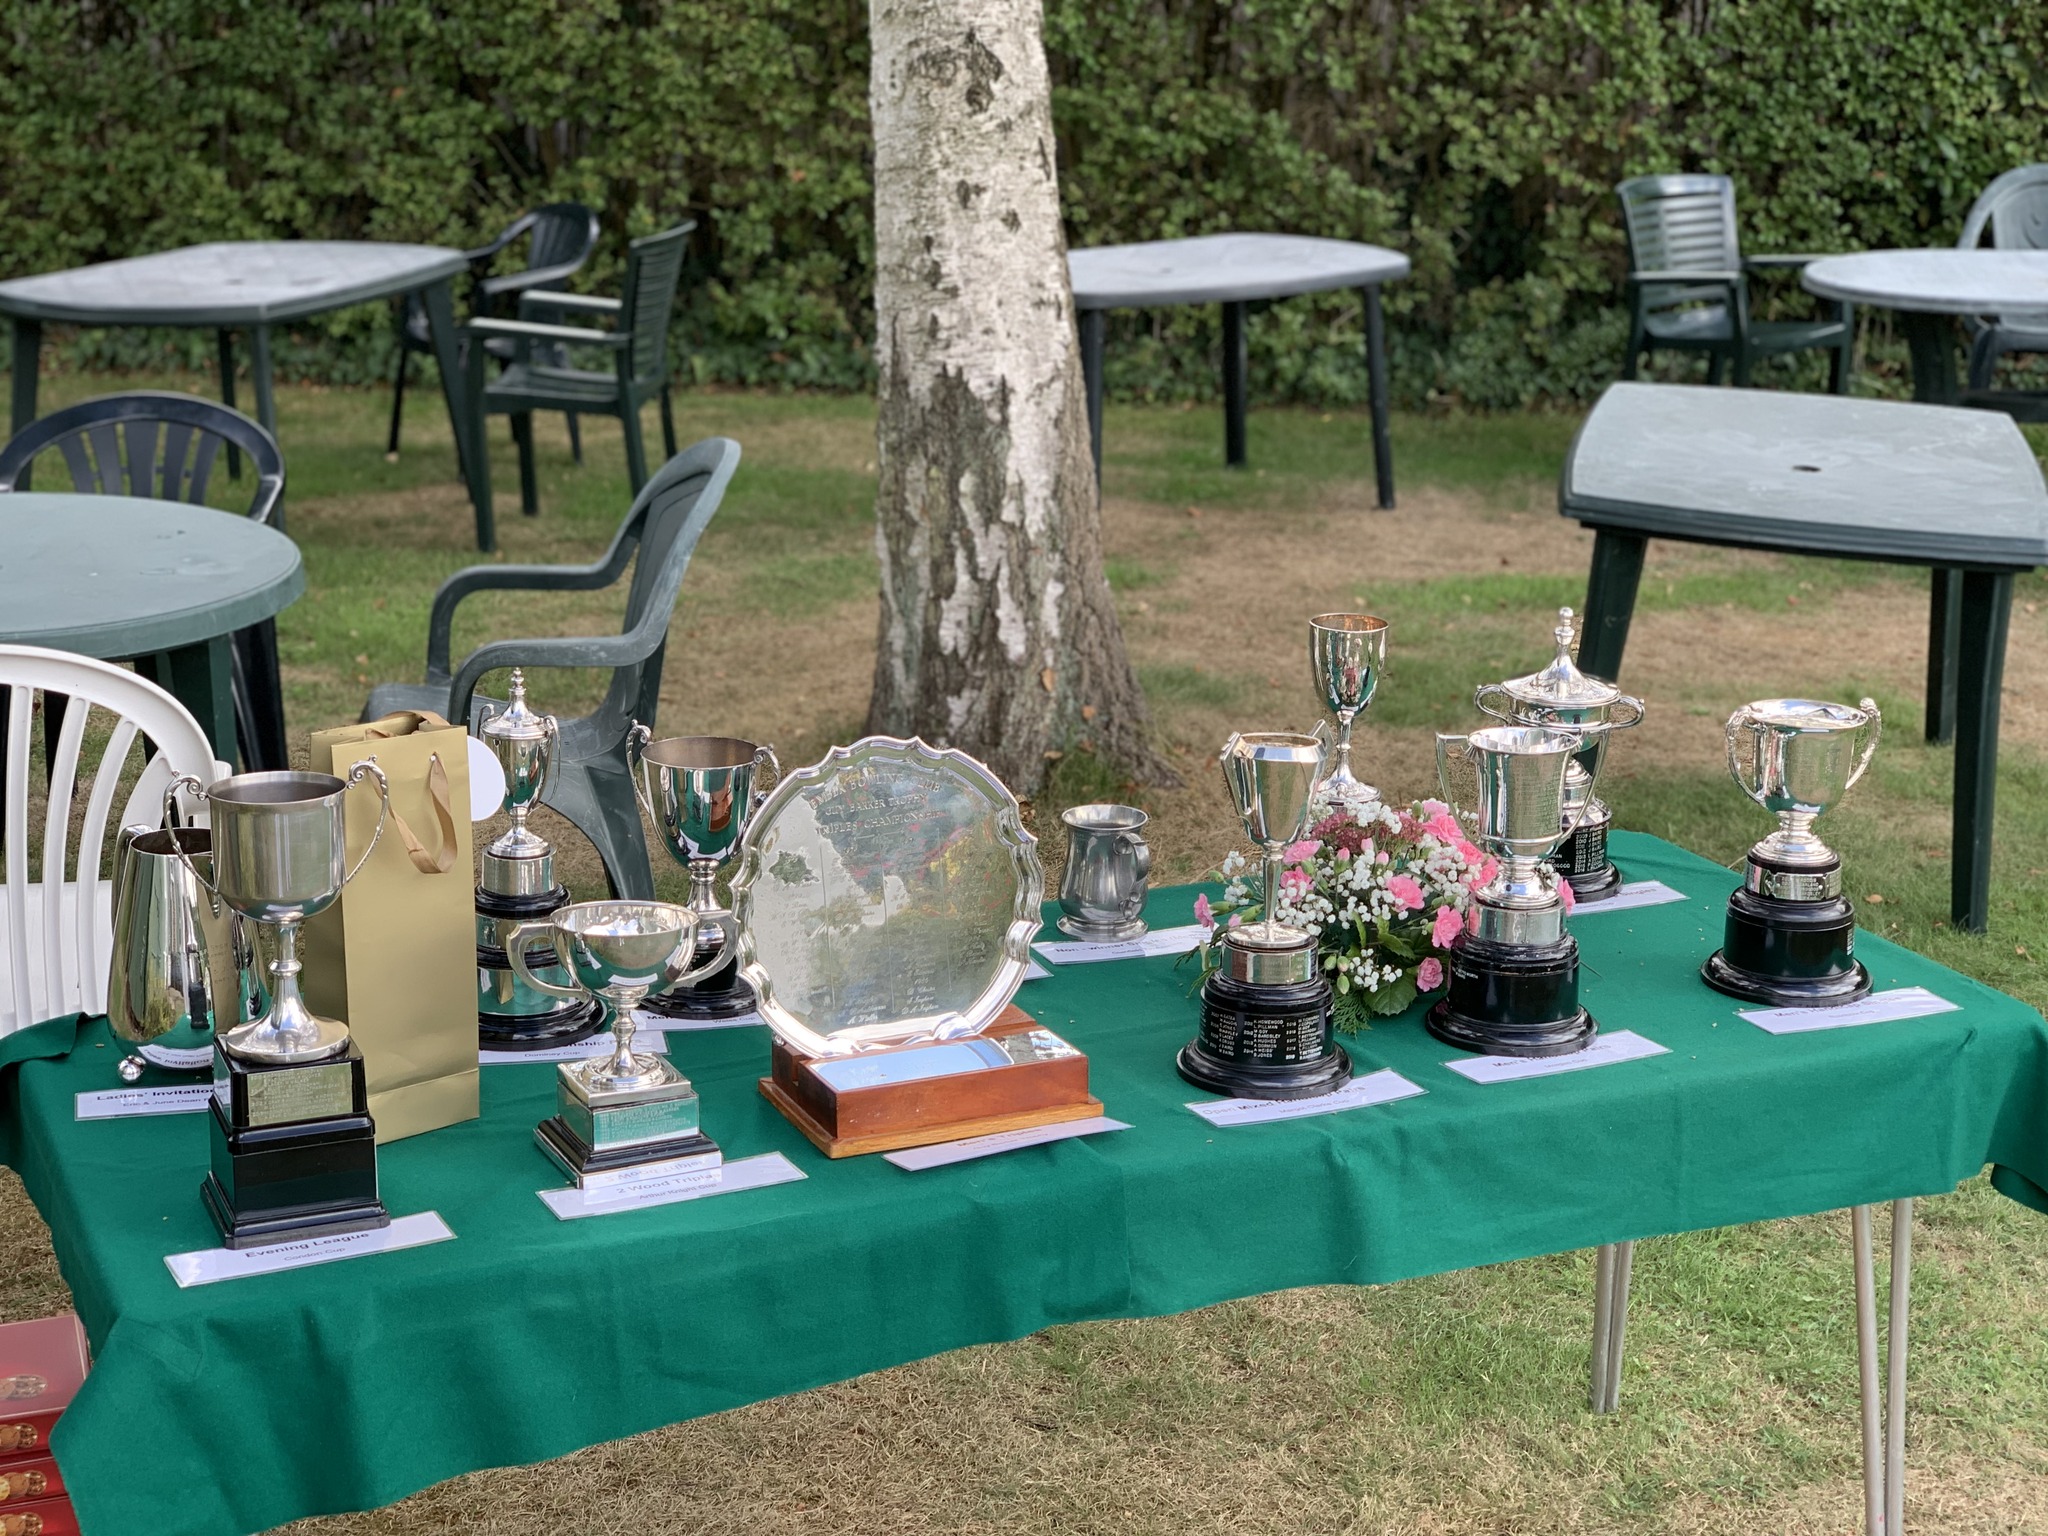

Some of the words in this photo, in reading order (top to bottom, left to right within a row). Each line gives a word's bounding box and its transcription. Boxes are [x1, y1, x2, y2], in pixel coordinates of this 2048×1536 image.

[850, 773, 904, 791] BOWLING
[910, 775, 942, 793] CLUB
[849, 798, 886, 813] BARKER
[887, 792, 928, 807] TROPHY
[816, 820, 858, 836] TRIPLES
[97, 1092, 148, 1101] Ladies'
[1202, 1107, 1235, 1117] Open
[1237, 1101, 1274, 1111] Mixed
[627, 1181, 671, 1193] Wood
[245, 1243, 309, 1258] Evening
[312, 1232, 370, 1247] League
[325, 1247, 346, 1257] Cup
